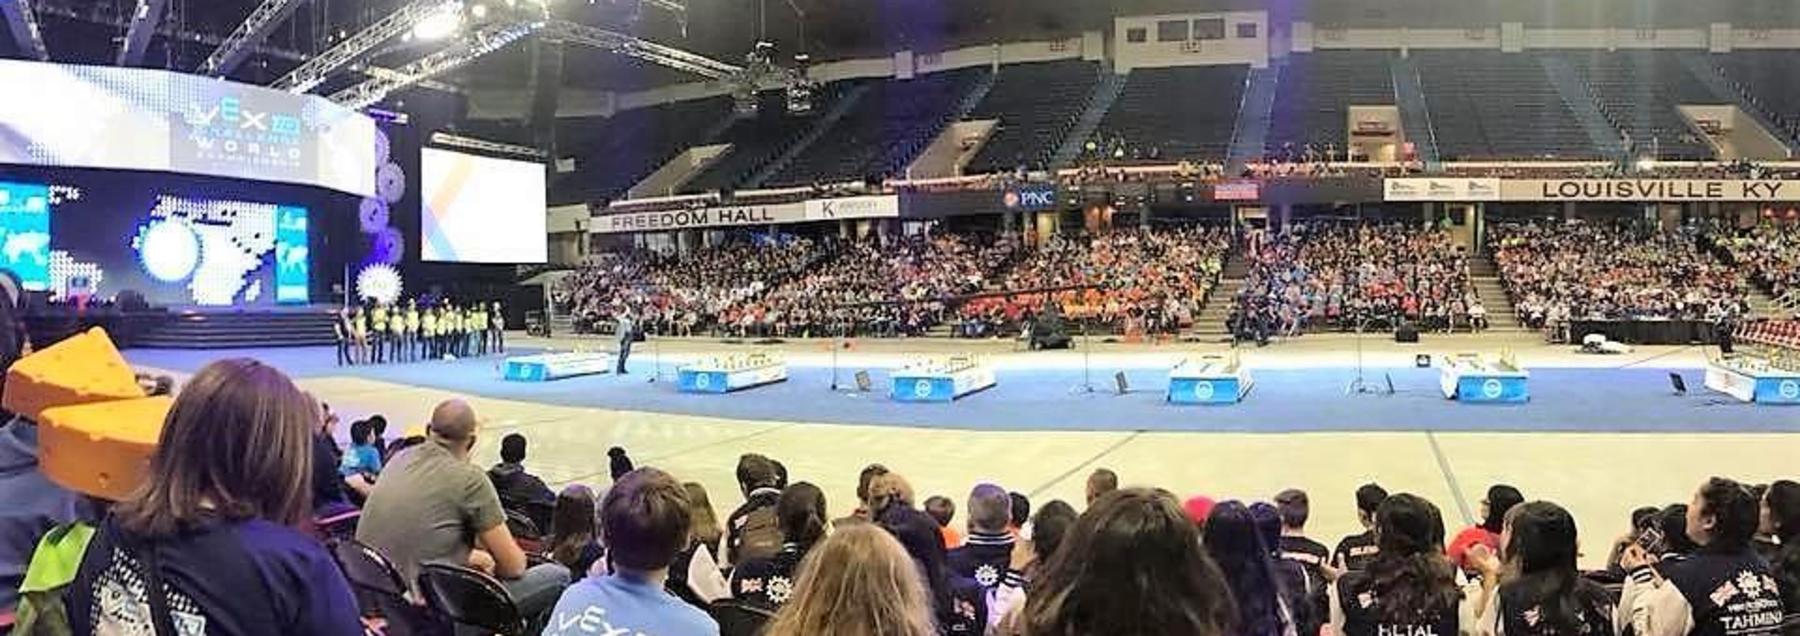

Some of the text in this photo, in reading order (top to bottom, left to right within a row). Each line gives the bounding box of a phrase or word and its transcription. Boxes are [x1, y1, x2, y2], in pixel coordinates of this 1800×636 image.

[189, 96, 267, 130] VEX
[194, 136, 302, 160] WORLD
[1021, 190, 1054, 206] PNC
[1542, 181, 1783, 199] LOUISVILLE KY
[611, 207, 775, 230] FREEDOM HALL
